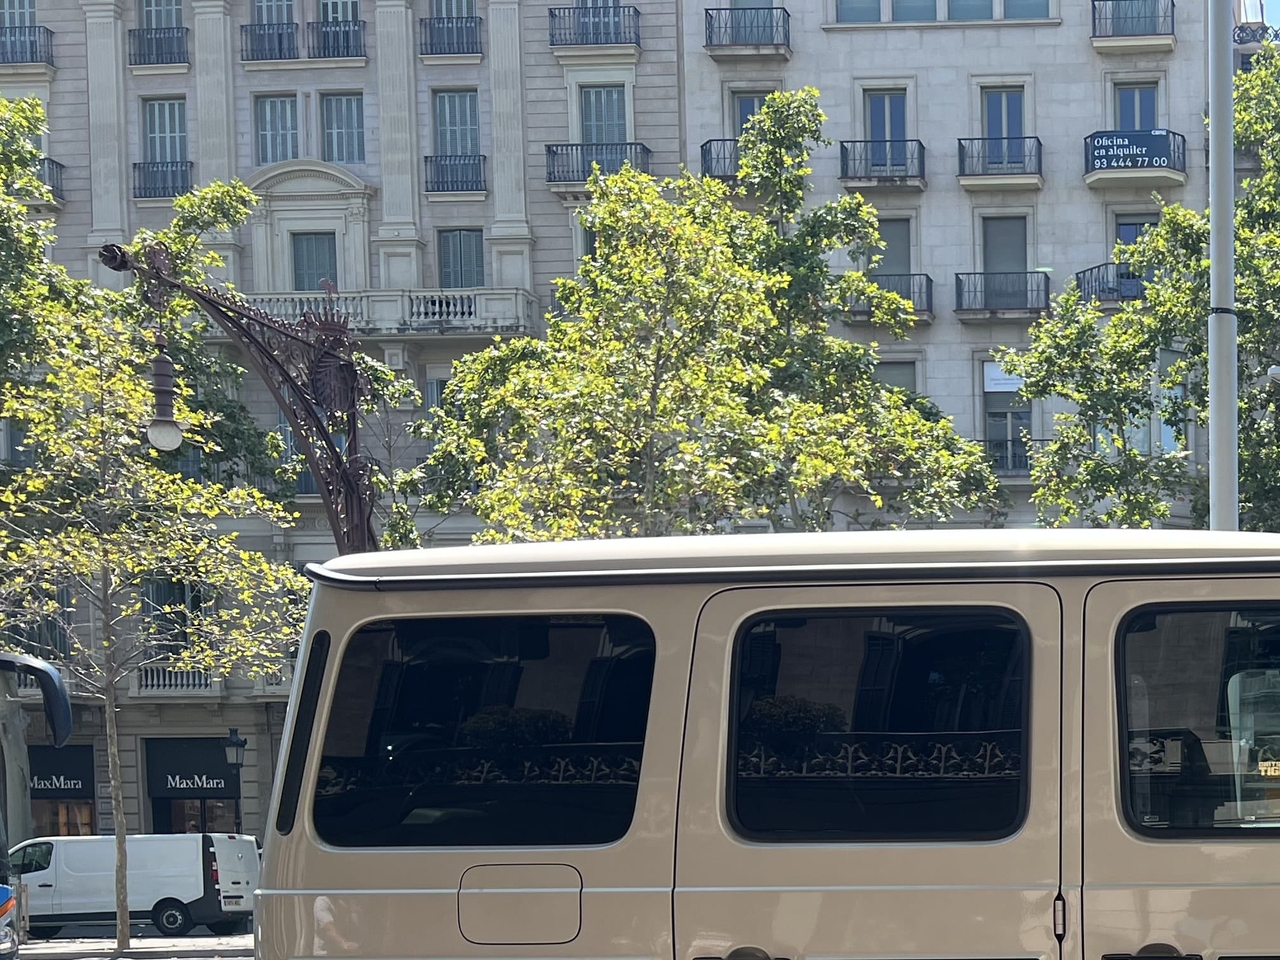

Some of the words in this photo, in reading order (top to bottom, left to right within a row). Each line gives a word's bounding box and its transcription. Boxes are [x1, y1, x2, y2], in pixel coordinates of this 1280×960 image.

[1094, 136, 1129, 147] Oficina
[1094, 148, 1106, 156] en
[1107, 145, 1147, 157] alquiler
[1094, 159, 1107, 169] 93
[1111, 158, 1132, 168] 444
[1136, 157, 1149, 167] 77
[1152, 157, 1168, 167] 00
[30, 775, 82, 789] MaxMara
[166, 774, 225, 789] MaxMara
